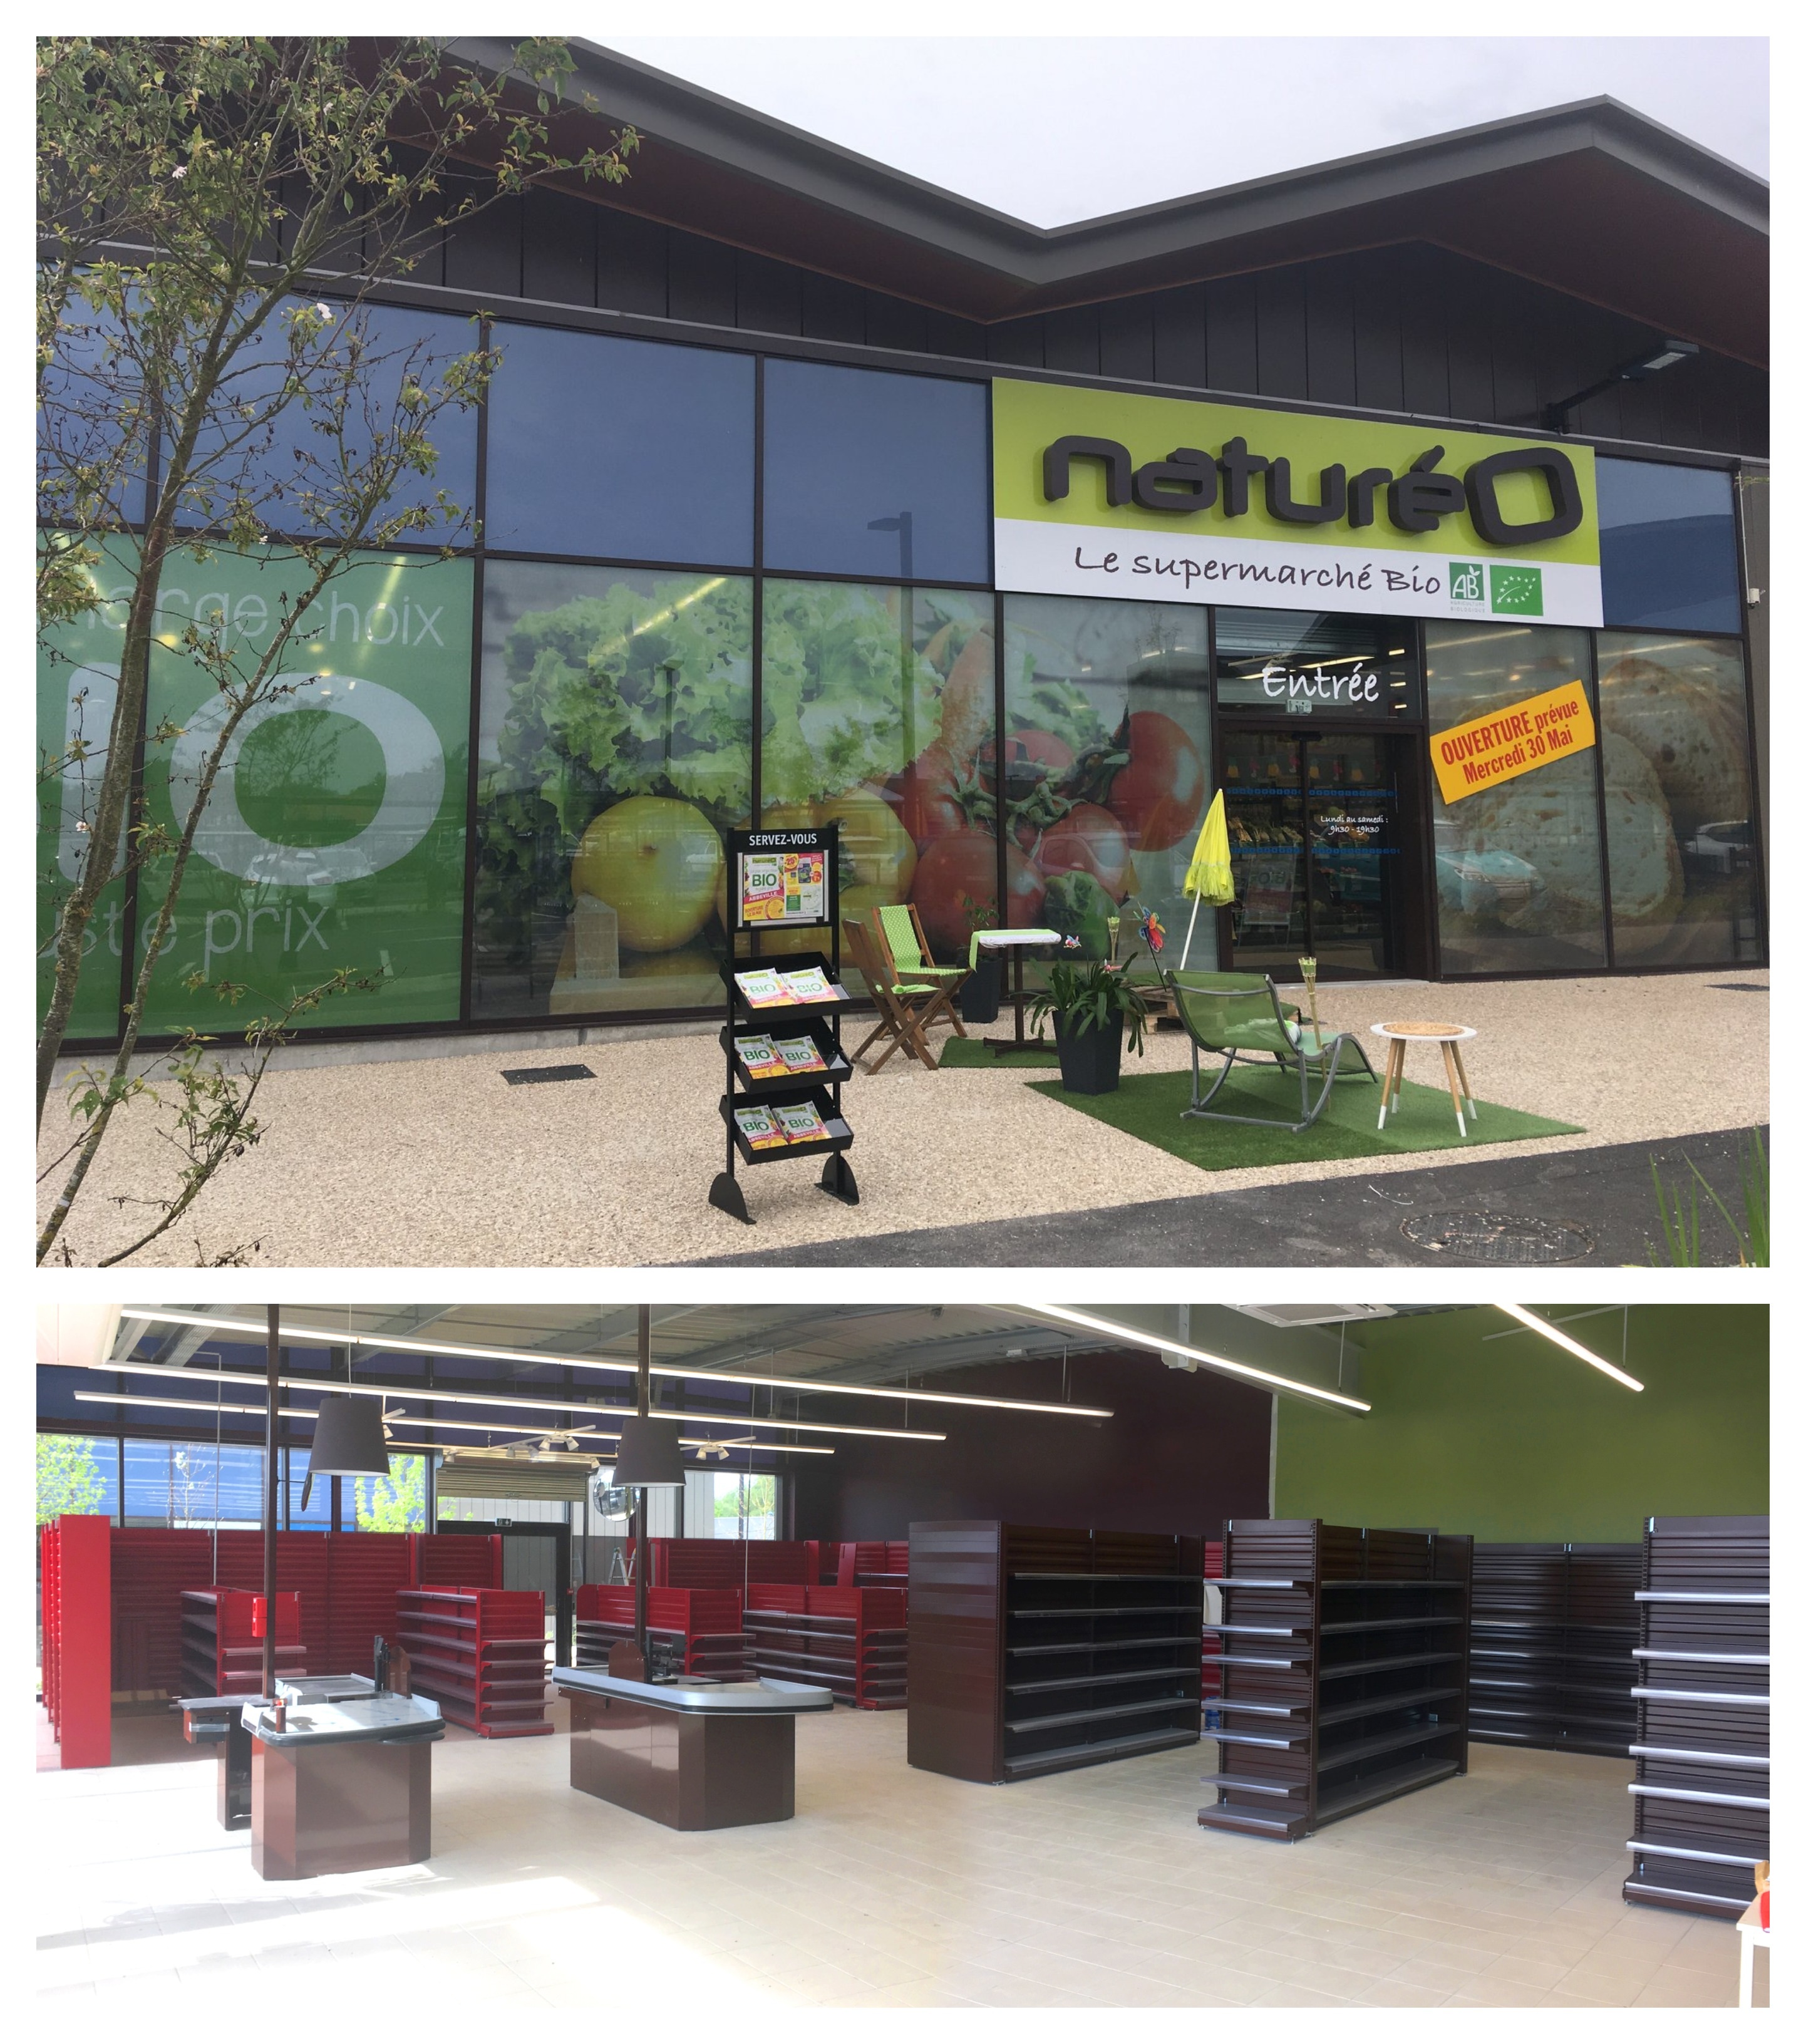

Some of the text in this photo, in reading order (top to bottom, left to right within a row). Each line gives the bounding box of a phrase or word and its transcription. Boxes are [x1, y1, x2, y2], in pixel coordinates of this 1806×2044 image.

[1042, 435, 1584, 546] naturéO
[1075, 540, 1441, 594] Le supermarché Bio
[1452, 574, 1479, 599] AB
[1262, 662, 1379, 702] Entrée
[1441, 703, 1579, 765] OUVERTURE prévue
[1462, 724, 1574, 784] Mercredi 30 Mai
[1320, 814, 1344, 823] Lundi
[1358, 815, 1385, 823] samedi
[1328, 825, 1350, 835] 9h30
[1356, 825, 1380, 835] 19h30
[749, 833, 817, 845] SERVEZ-VOUS
[752, 873, 777, 887] BIO
[748, 891, 778, 902] ABBEVILLE
[204, 899, 329, 983] prix
[750, 984, 777, 994] BIO
[797, 983, 823, 993] BIO
[743, 1050, 771, 1061] BIO
[785, 1051, 812, 1061] BIO
[743, 1121, 770, 1132] BIO
[788, 1118, 815, 1128] BIO
